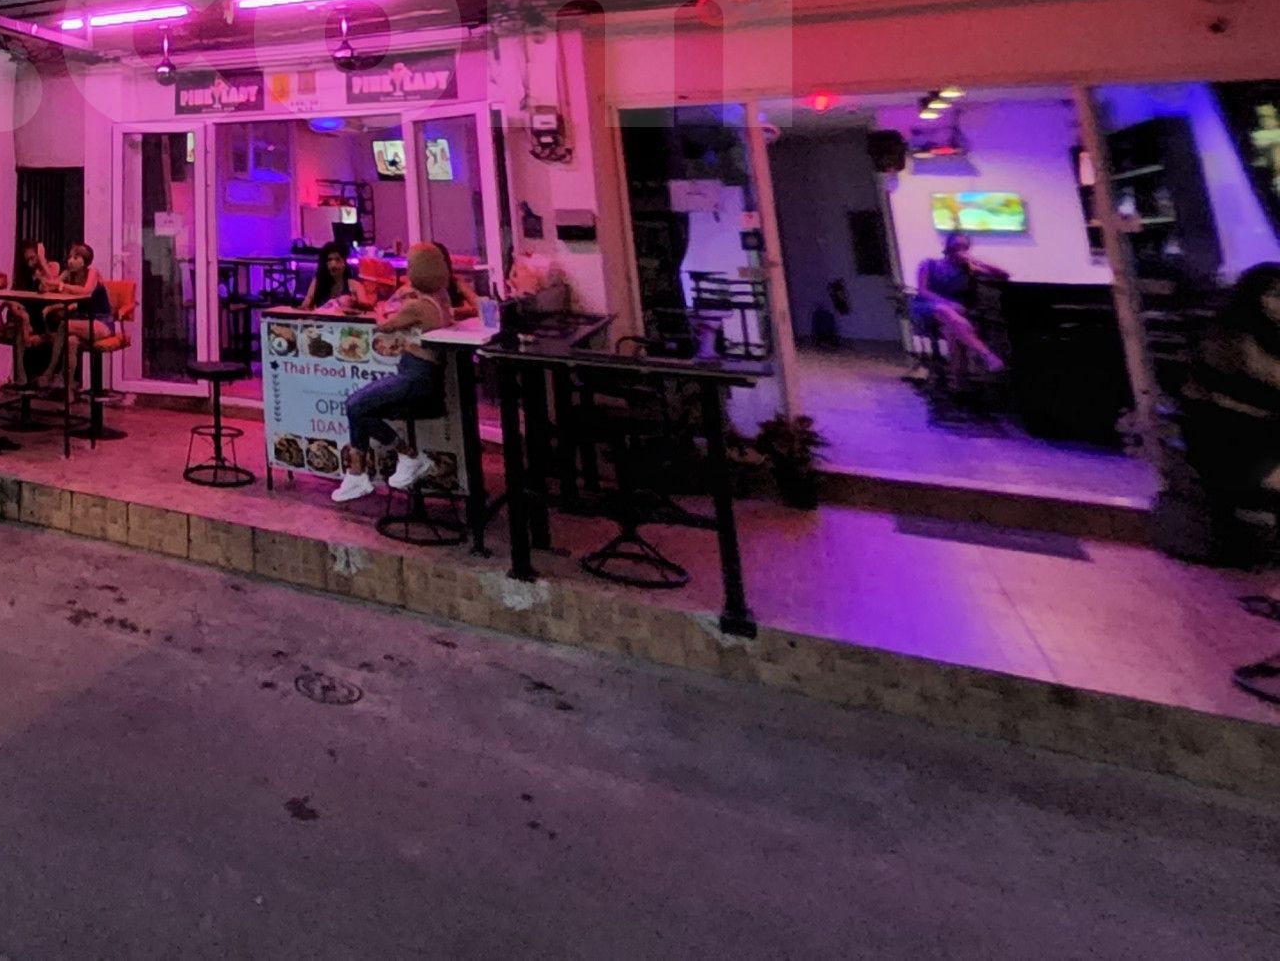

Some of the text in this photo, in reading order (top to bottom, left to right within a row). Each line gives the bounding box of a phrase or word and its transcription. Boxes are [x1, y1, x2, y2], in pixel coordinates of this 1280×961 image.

[352, 70, 449, 94] PINK LADY
[180, 85, 259, 106] PINK LADY
[283, 361, 310, 374] Thai
[314, 363, 346, 378] Food
